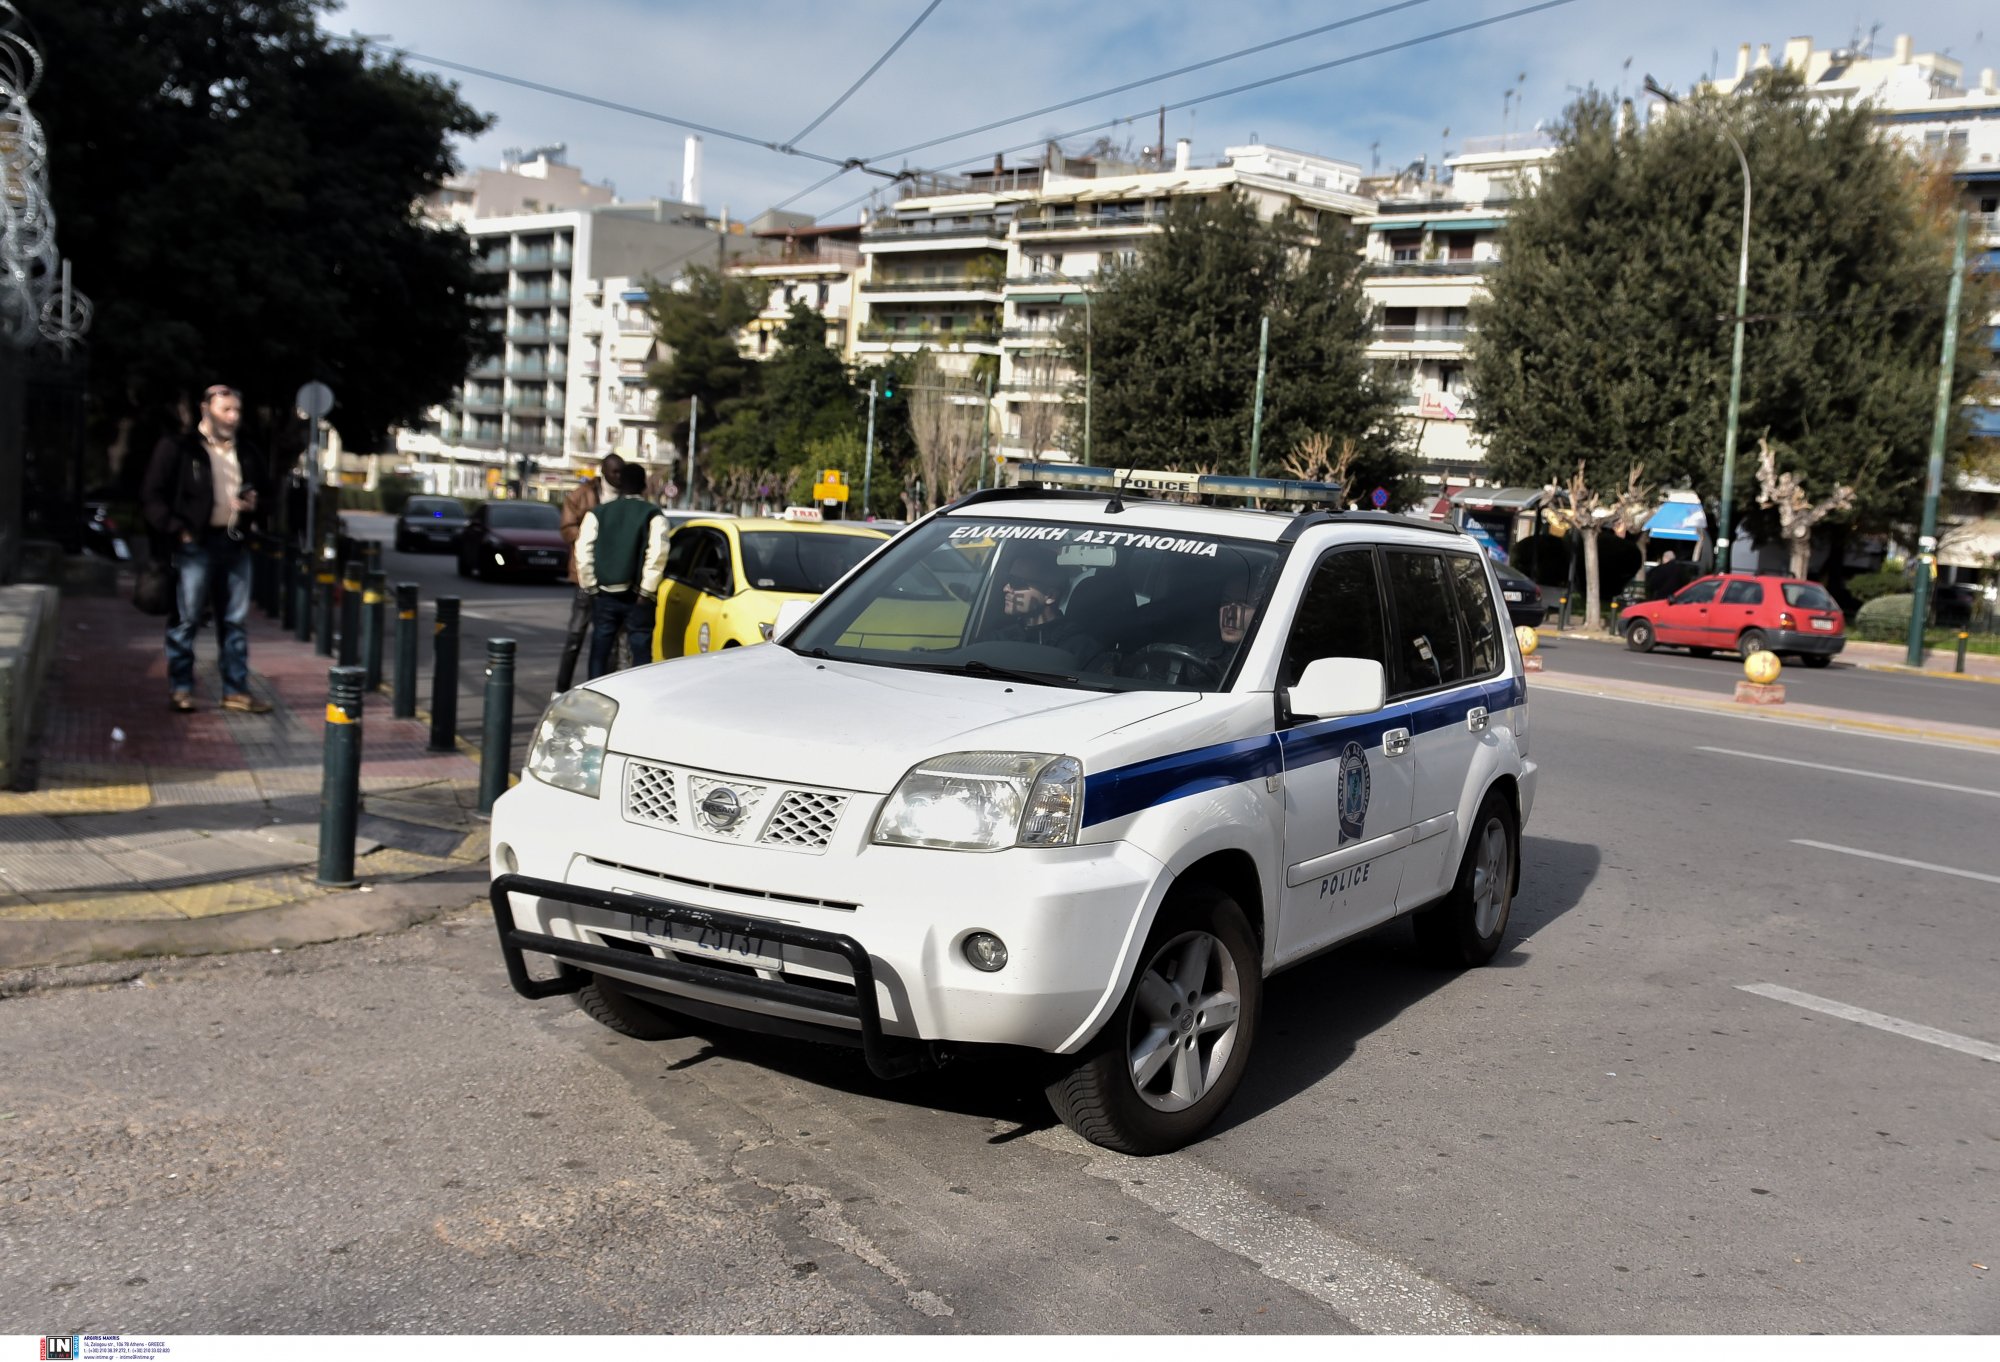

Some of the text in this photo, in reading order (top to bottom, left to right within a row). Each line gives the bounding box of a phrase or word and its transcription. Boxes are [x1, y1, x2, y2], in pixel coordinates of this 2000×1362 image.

[1121, 478, 1190, 492] POLICE
[948, 526, 1219, 557] ΕΛΛΗΝΙΚΗ ΑΣΤΥΝΟΜΙΑ
[1320, 863, 1371, 899] POLICE
